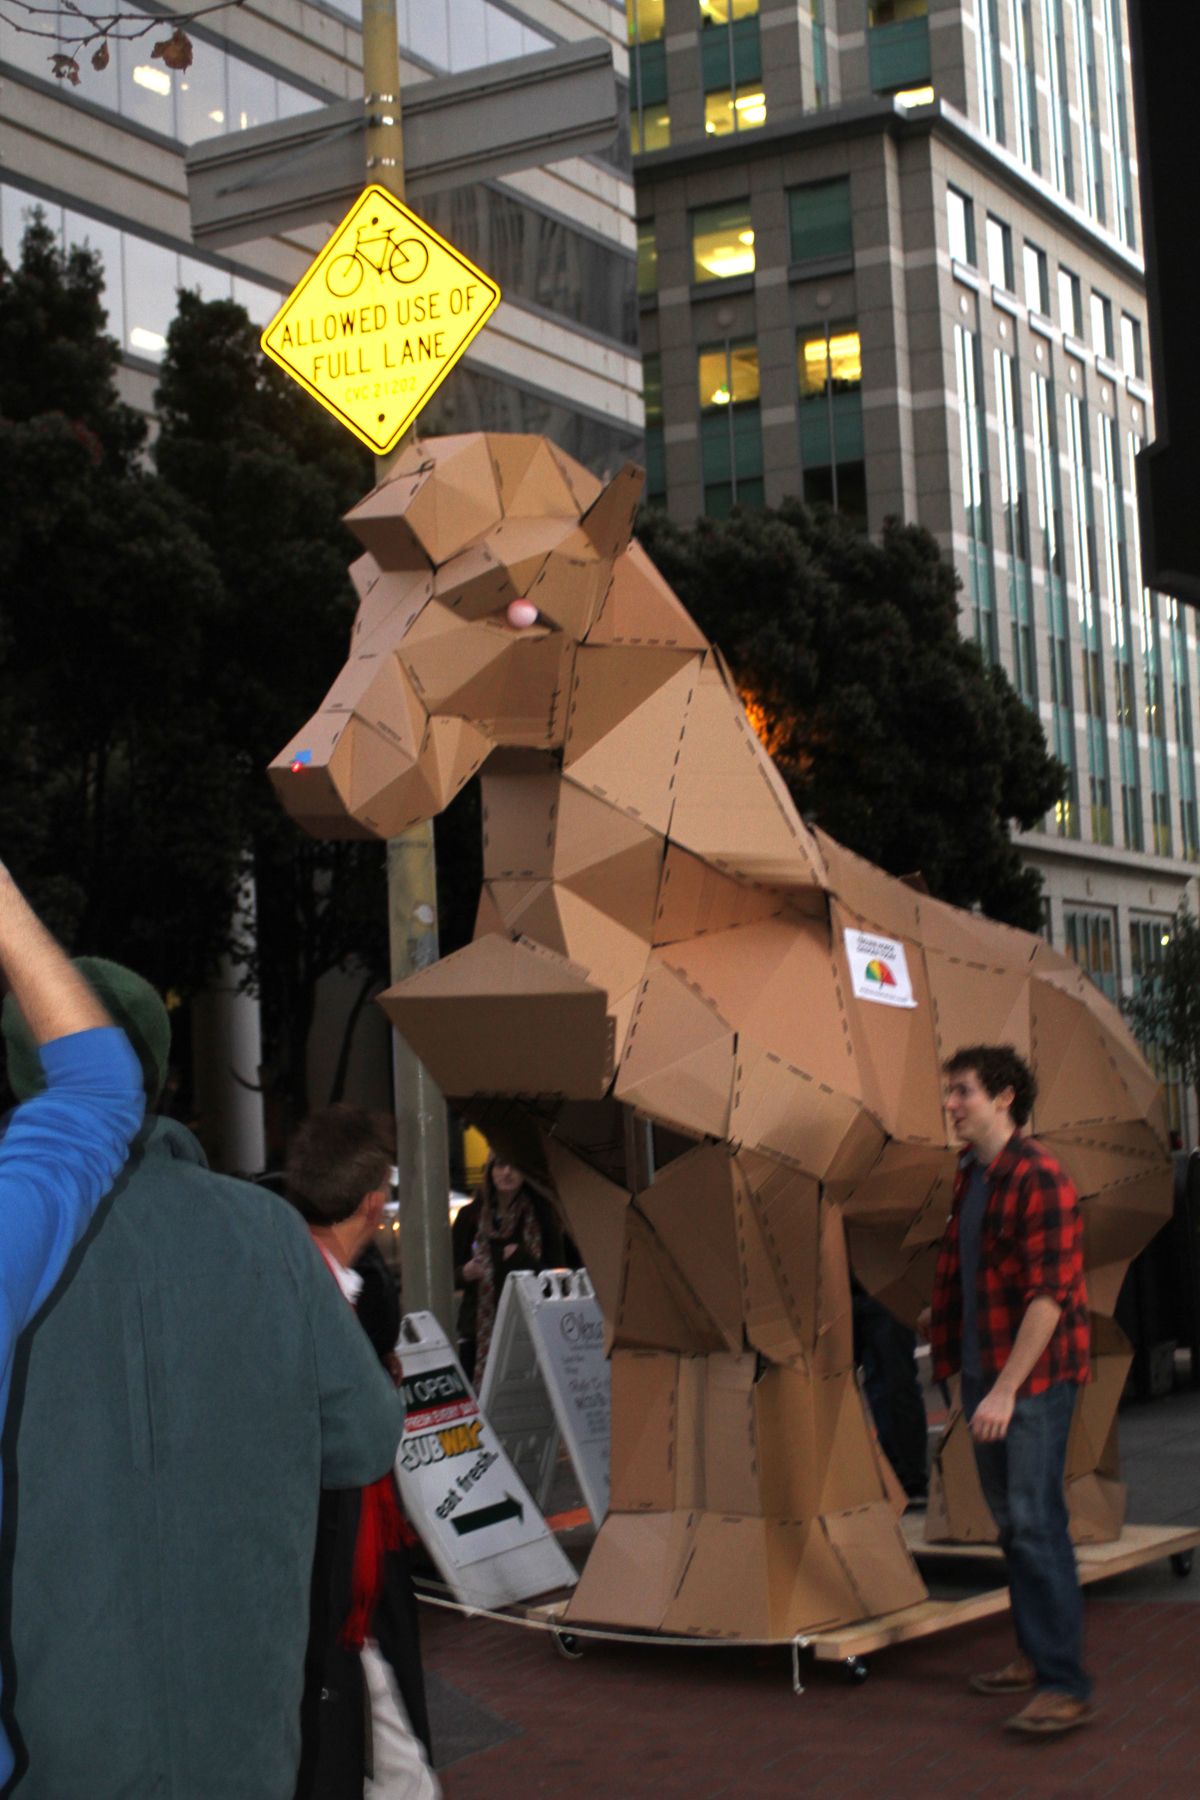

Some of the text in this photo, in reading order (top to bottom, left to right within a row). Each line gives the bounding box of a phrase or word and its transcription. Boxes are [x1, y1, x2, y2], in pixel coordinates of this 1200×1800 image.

[281, 284, 478, 350] ALLOWED USE OF
[313, 331, 446, 383] FULL LANE
[413, 1373, 464, 1402] OPEN
[401, 1418, 484, 1471] SUBWAY
[435, 1488, 463, 1520] eat
